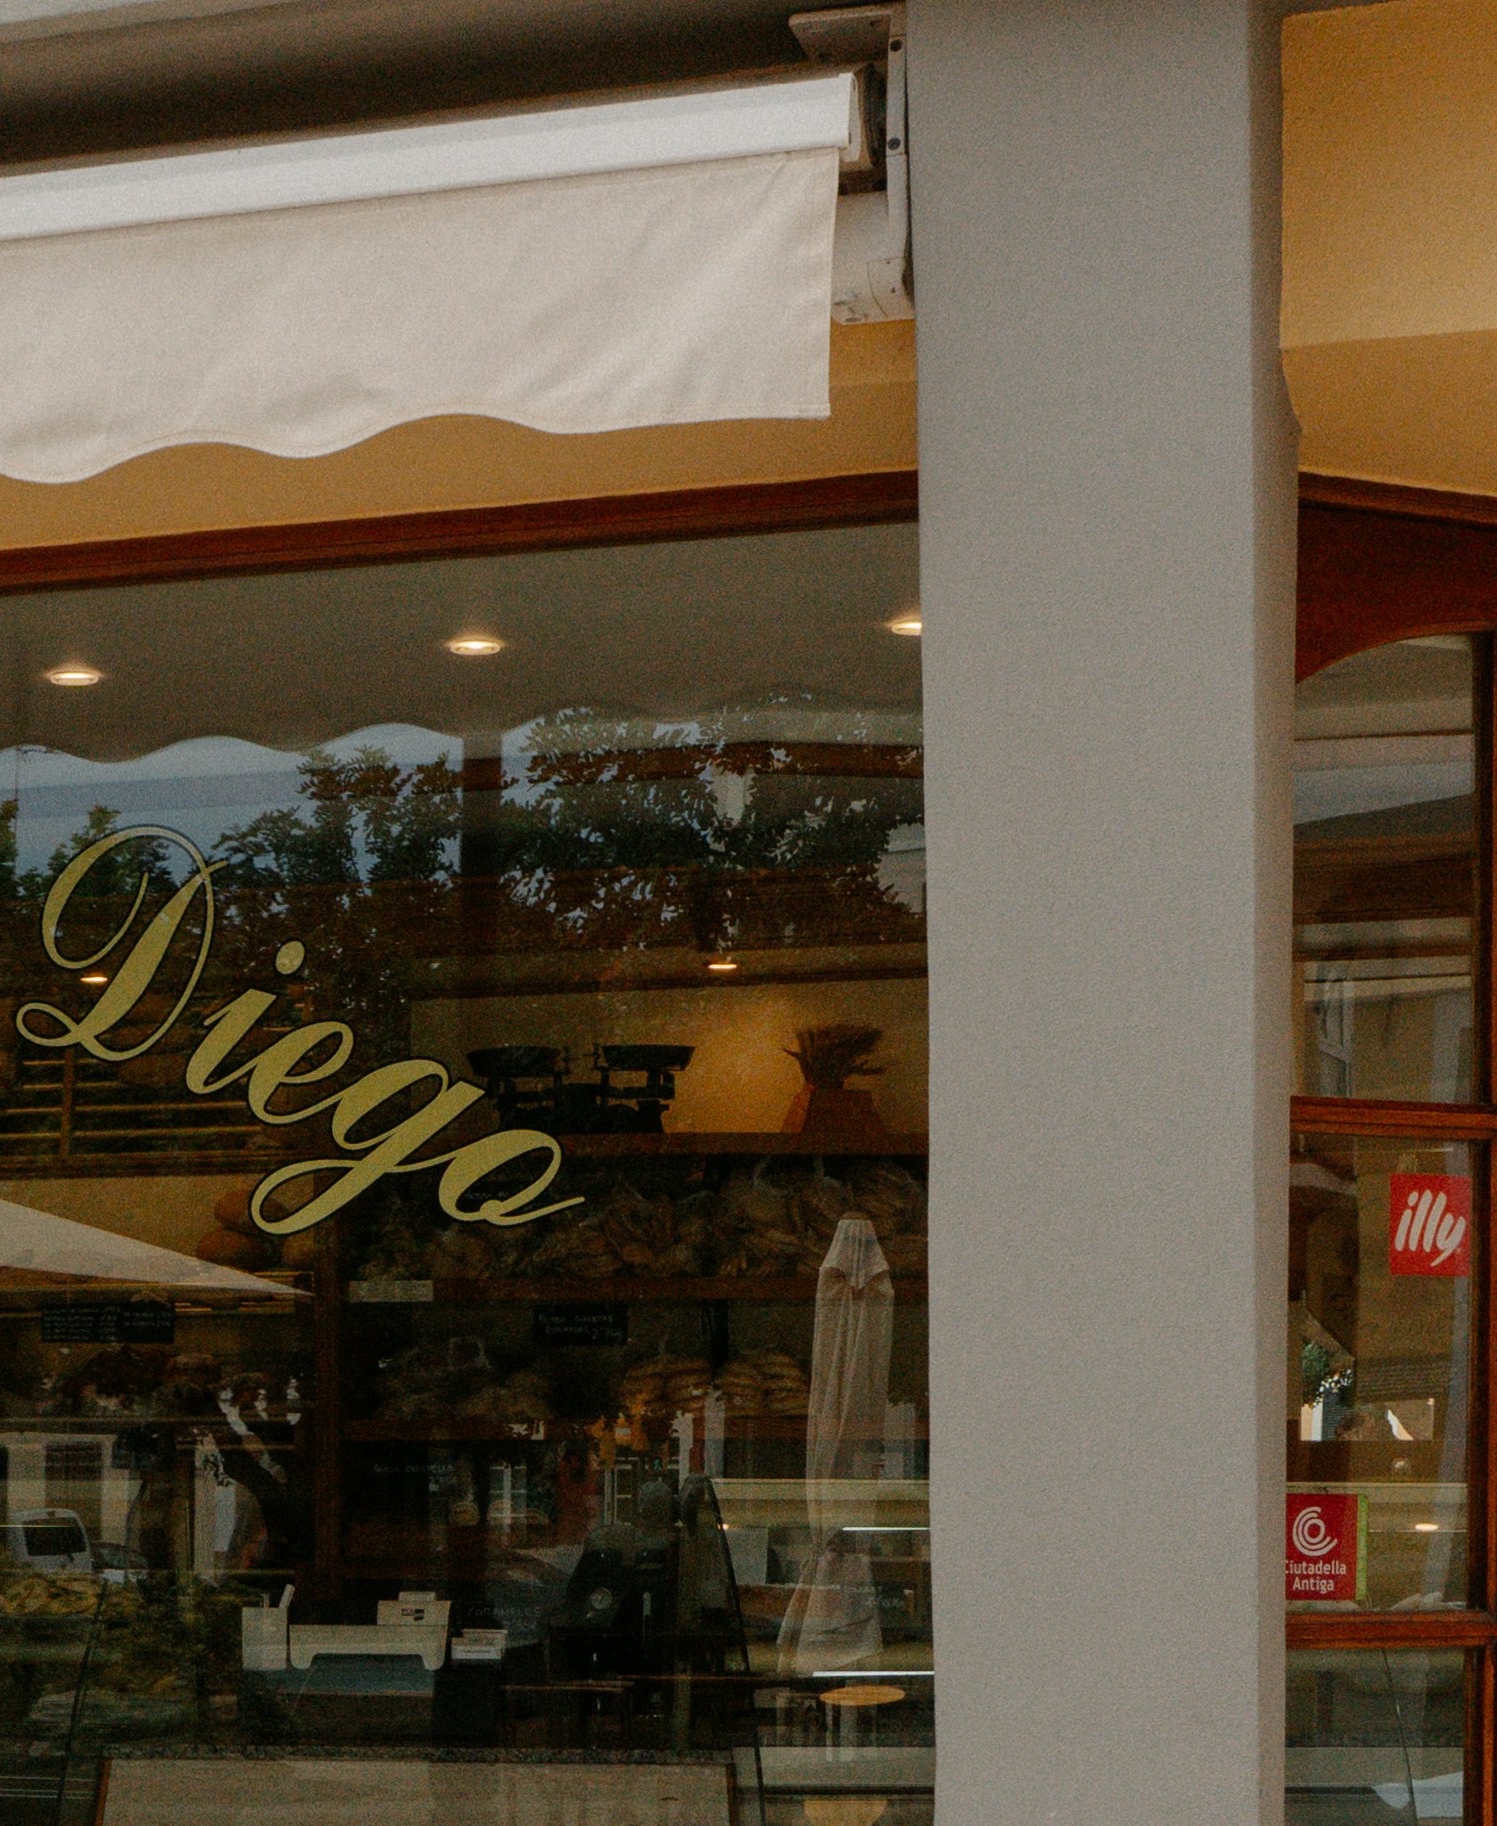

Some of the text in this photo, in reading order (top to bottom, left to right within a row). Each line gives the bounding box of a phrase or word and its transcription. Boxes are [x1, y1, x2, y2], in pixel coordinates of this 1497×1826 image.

[16, 824, 588, 1237] Diego
[1396, 1190, 1466, 1266] illy
[1293, 1577, 1334, 1593] Antiga
